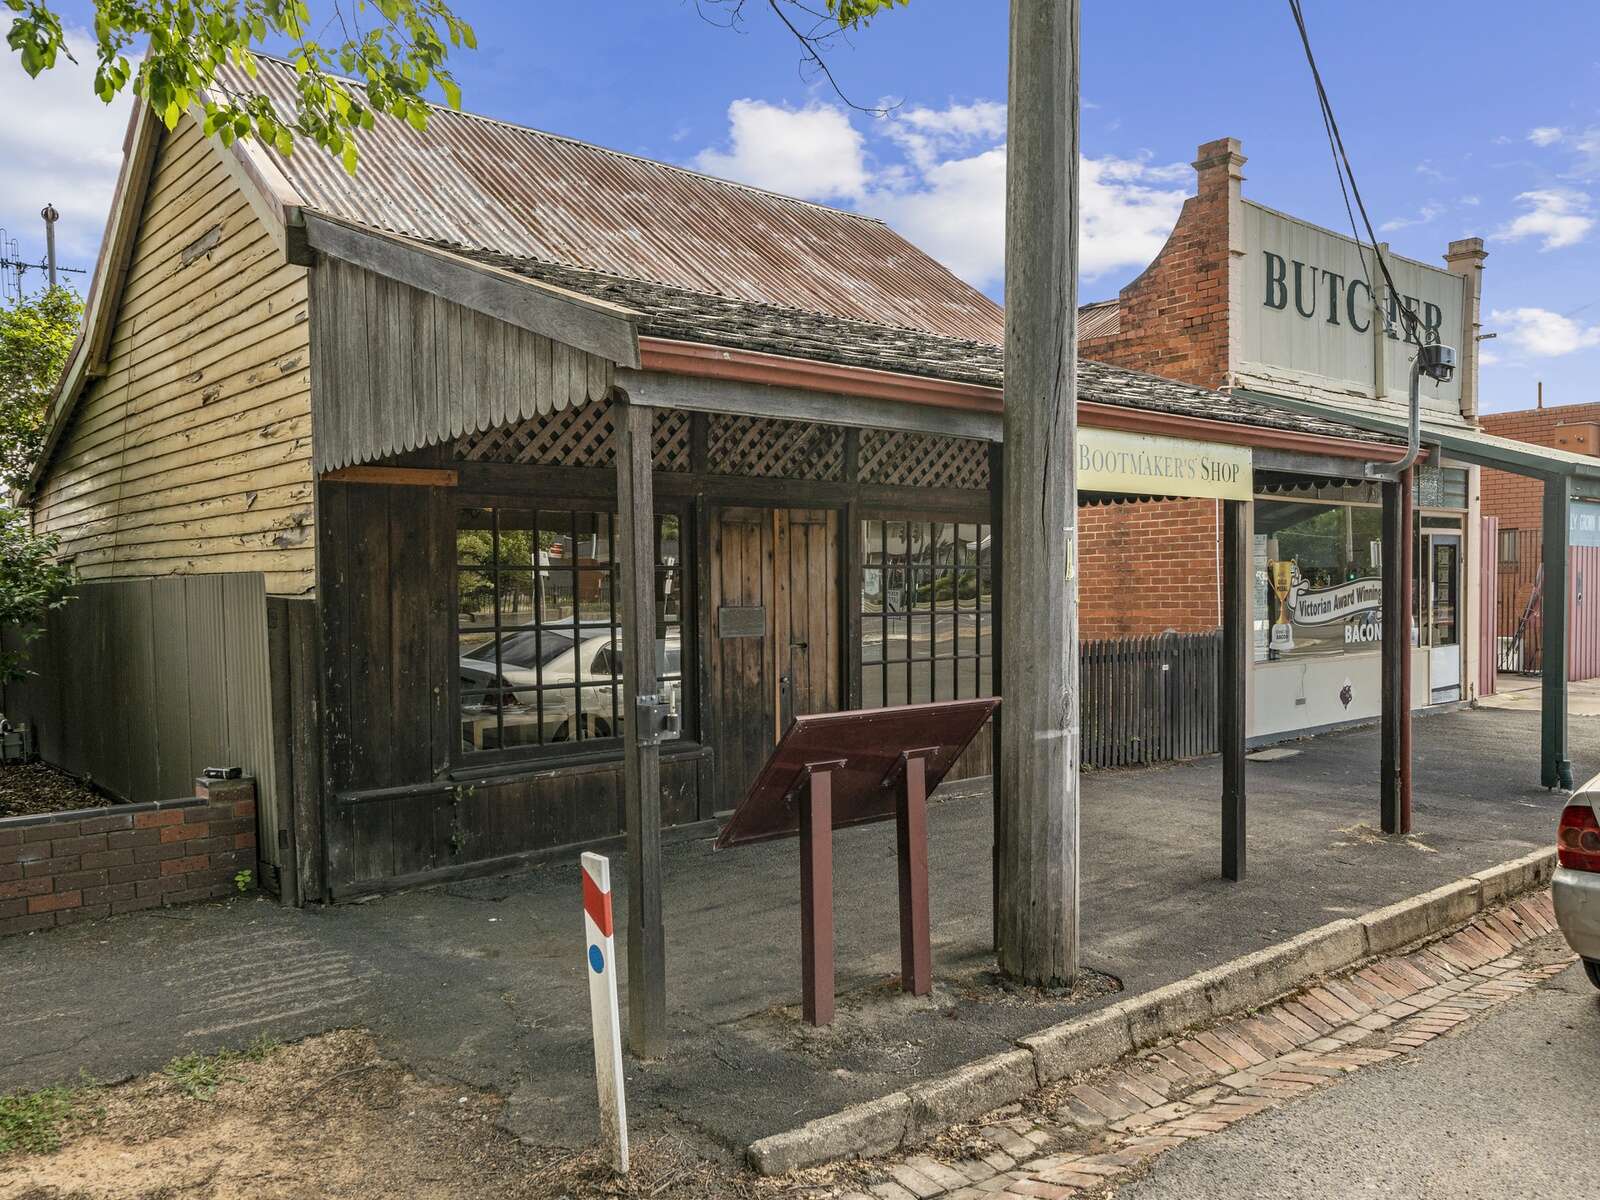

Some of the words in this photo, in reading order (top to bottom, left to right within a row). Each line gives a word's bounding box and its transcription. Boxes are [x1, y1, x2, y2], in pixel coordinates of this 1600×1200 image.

[1201, 456, 1240, 483] SHOP
[1299, 597, 1332, 617] Victorian
[1333, 590, 1355, 611] Award
[1344, 623, 1382, 643] BACON
